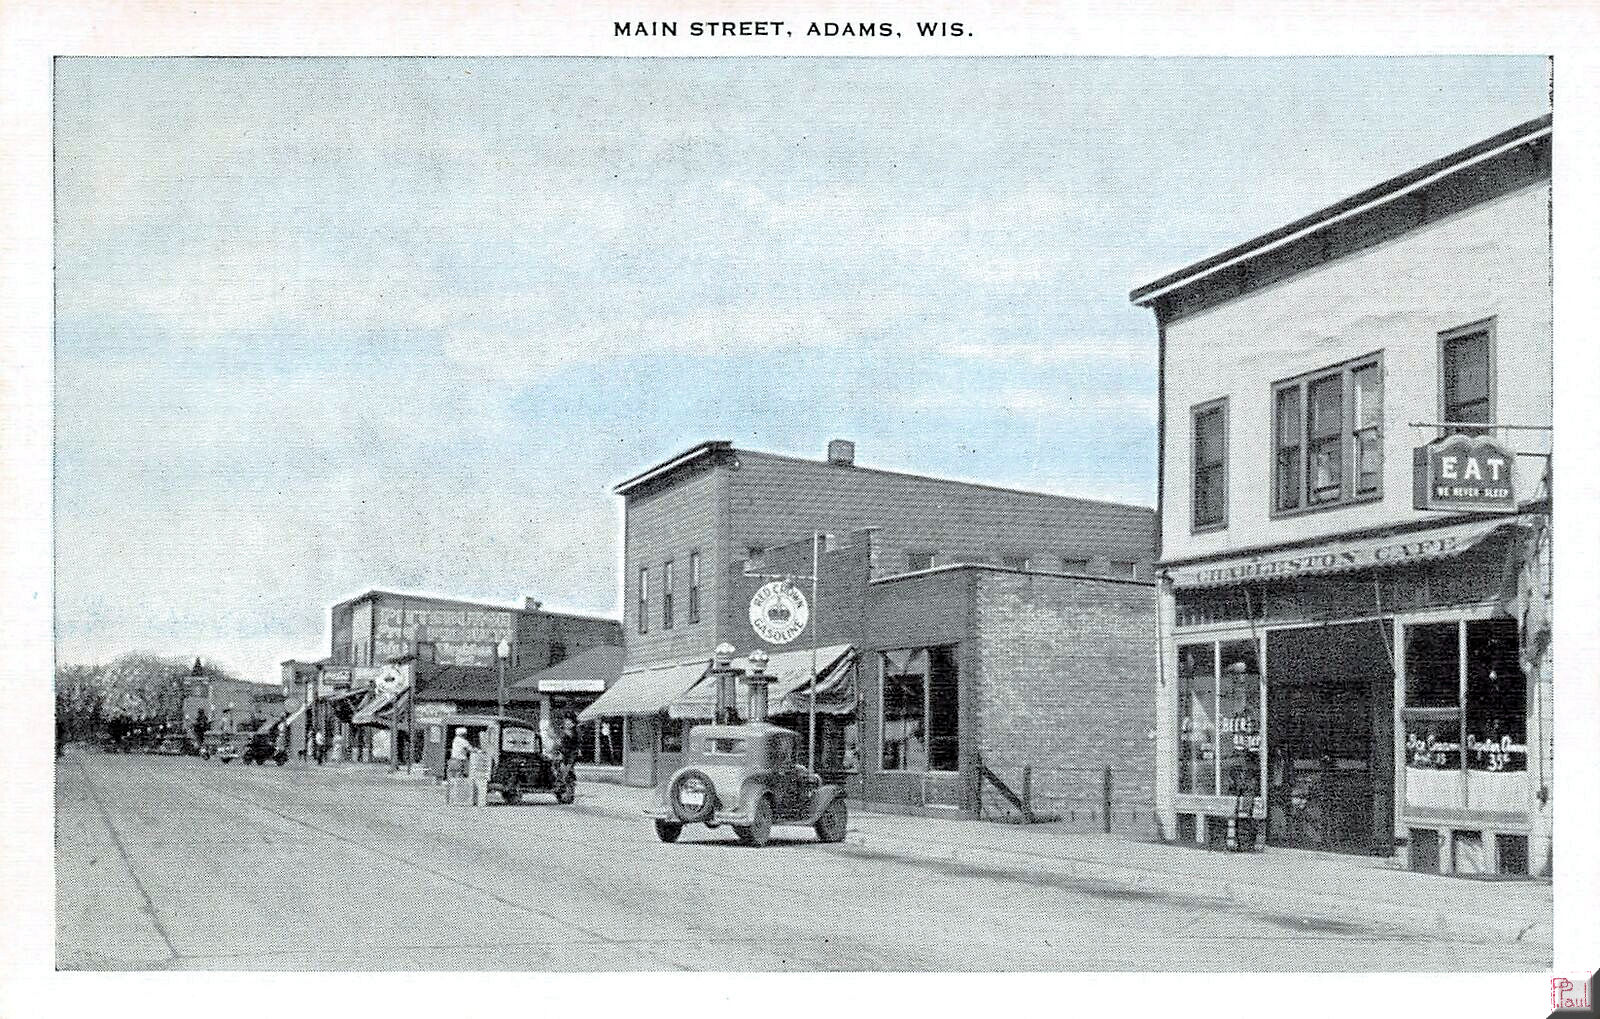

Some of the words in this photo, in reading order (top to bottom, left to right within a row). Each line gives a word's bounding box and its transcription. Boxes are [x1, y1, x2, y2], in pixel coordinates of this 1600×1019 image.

[1441, 456, 1504, 481] EAT
[1437, 486, 1449, 497] WE
[1453, 487, 1479, 497] NEVER
[1484, 488, 1509, 498] SLEEP
[1195, 549, 1360, 584] CHARLESTON
[1374, 536, 1459, 561] CAFE
[753, 587, 772, 607] RED
[753, 618, 804, 642] GASOLINE
